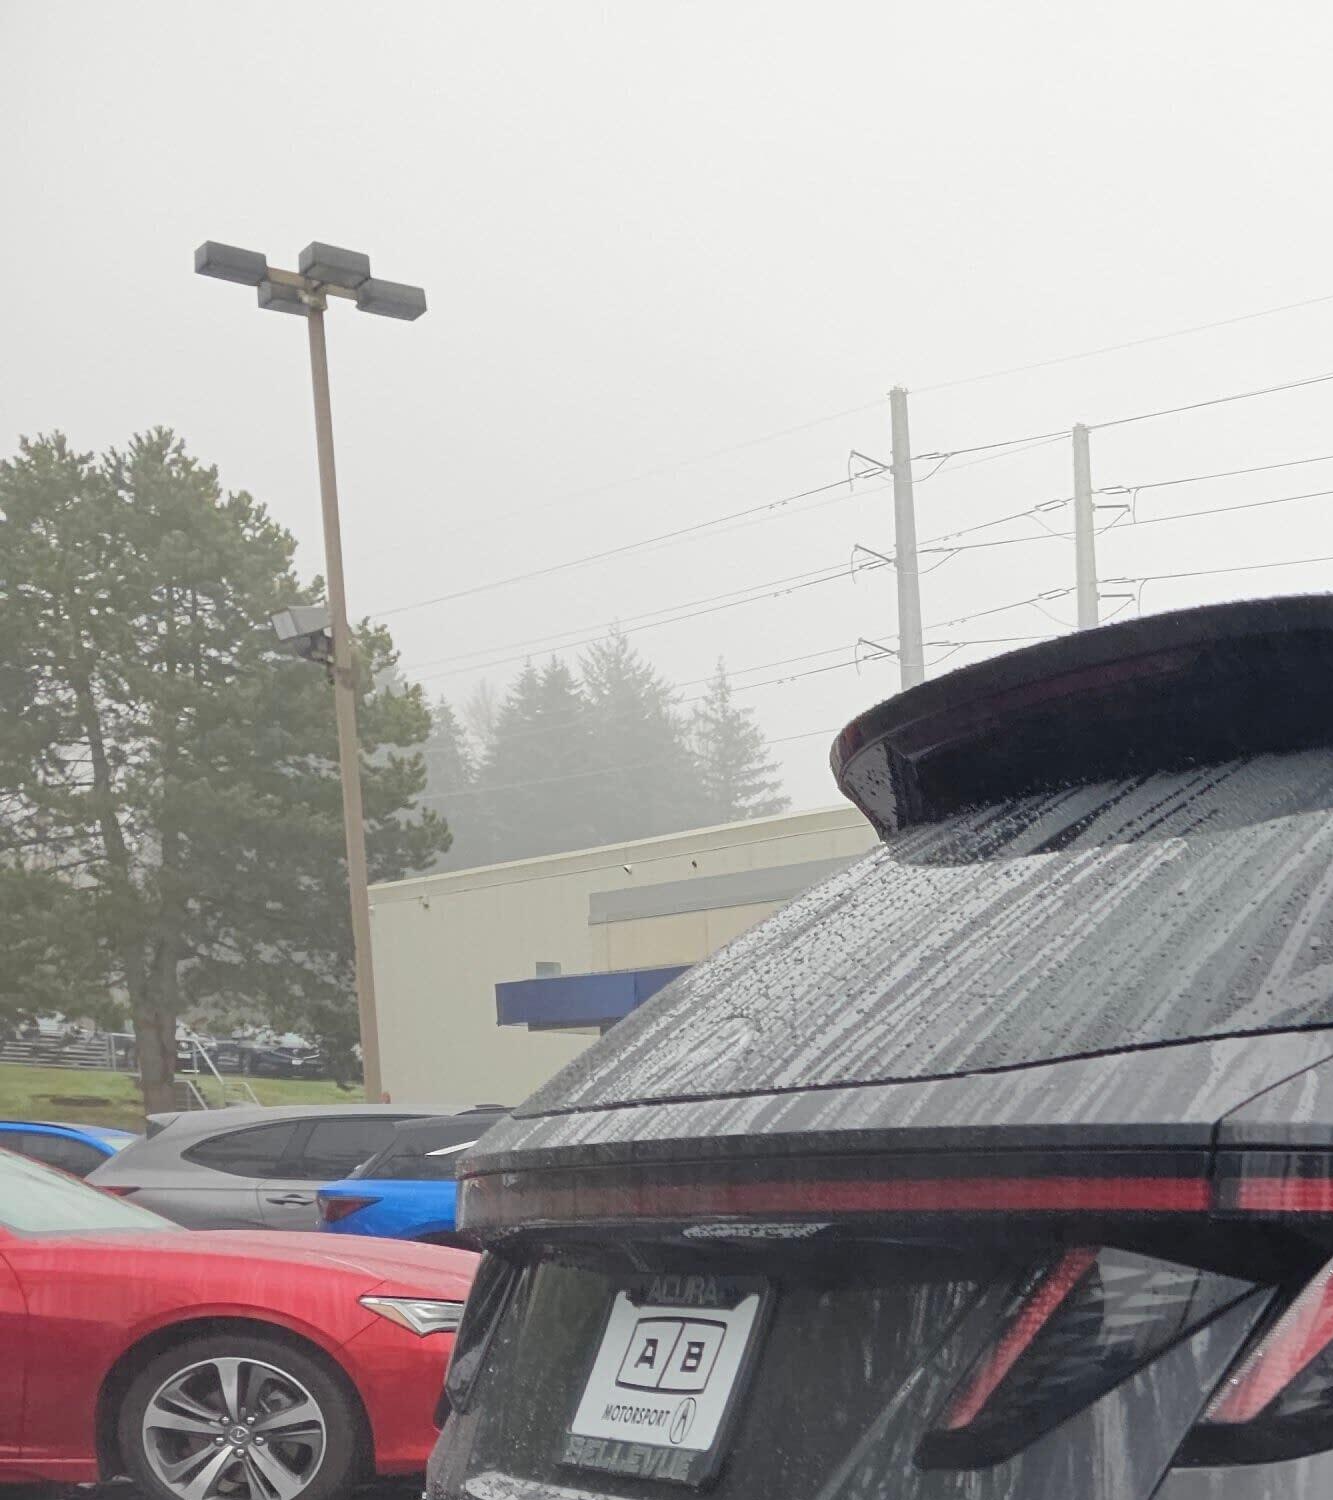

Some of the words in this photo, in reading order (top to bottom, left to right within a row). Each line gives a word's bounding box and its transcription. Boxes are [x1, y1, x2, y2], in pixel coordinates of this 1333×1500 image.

[646, 1275, 719, 1306] ACURA
[601, 1403, 671, 1427] MOTORSPORT
[562, 1435, 698, 1481] BELLEVUE
